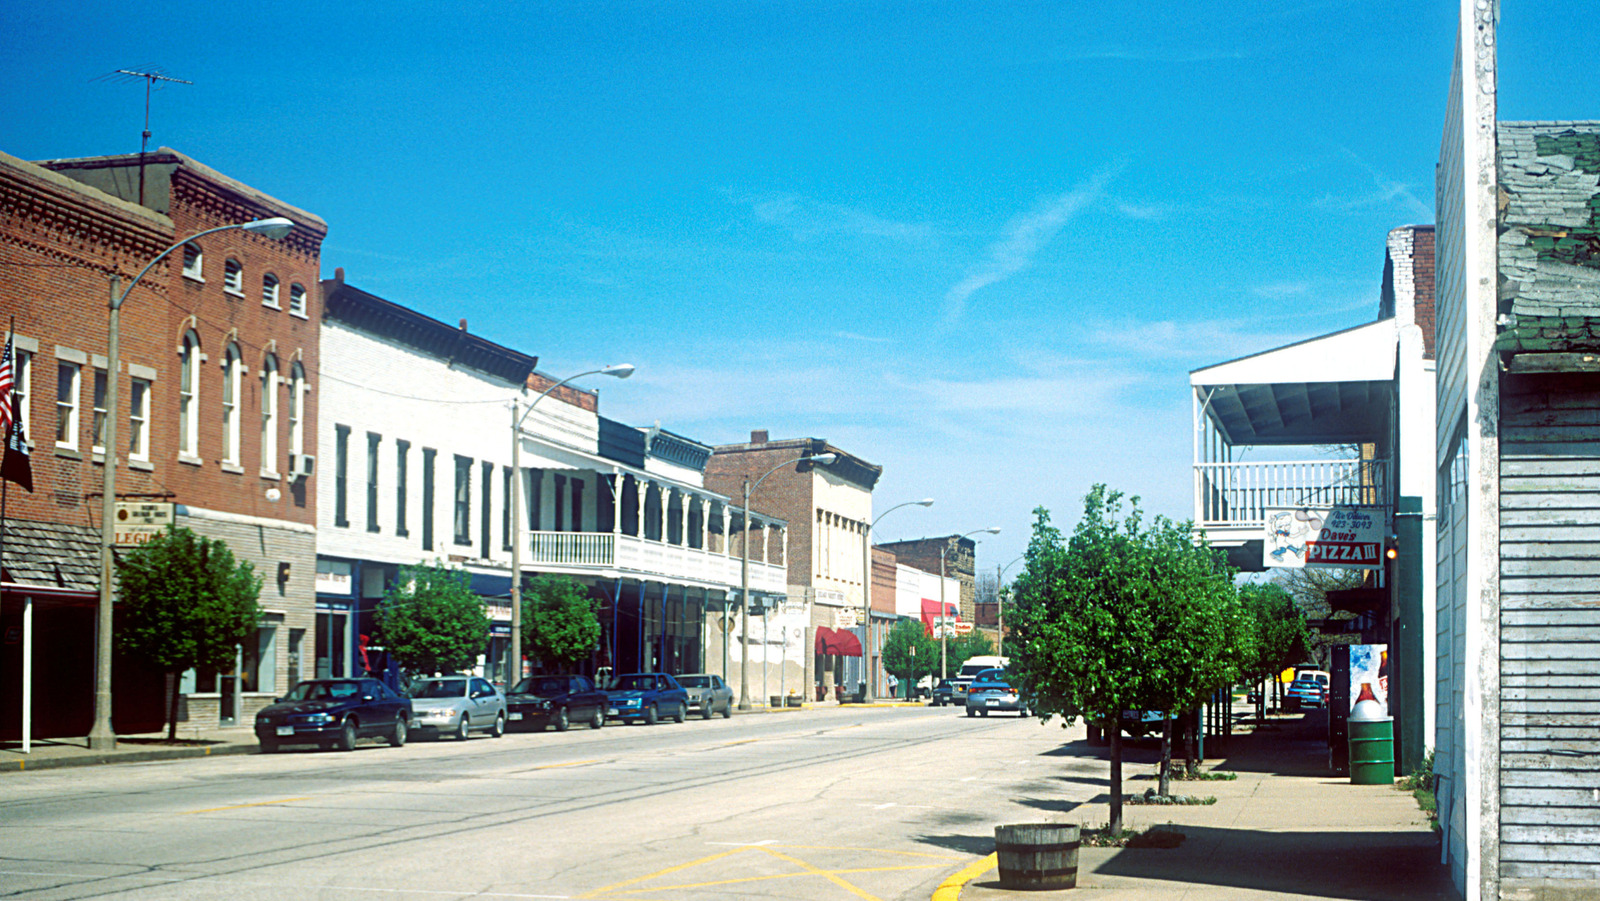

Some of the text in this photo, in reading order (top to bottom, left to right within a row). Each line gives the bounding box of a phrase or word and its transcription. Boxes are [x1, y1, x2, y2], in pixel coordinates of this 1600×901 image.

[1331, 520, 1372, 529] 923-3093
[115, 532, 167, 544] LEGI
[1321, 528, 1357, 541] Dave's
[1309, 544, 1363, 560] PIZZA
